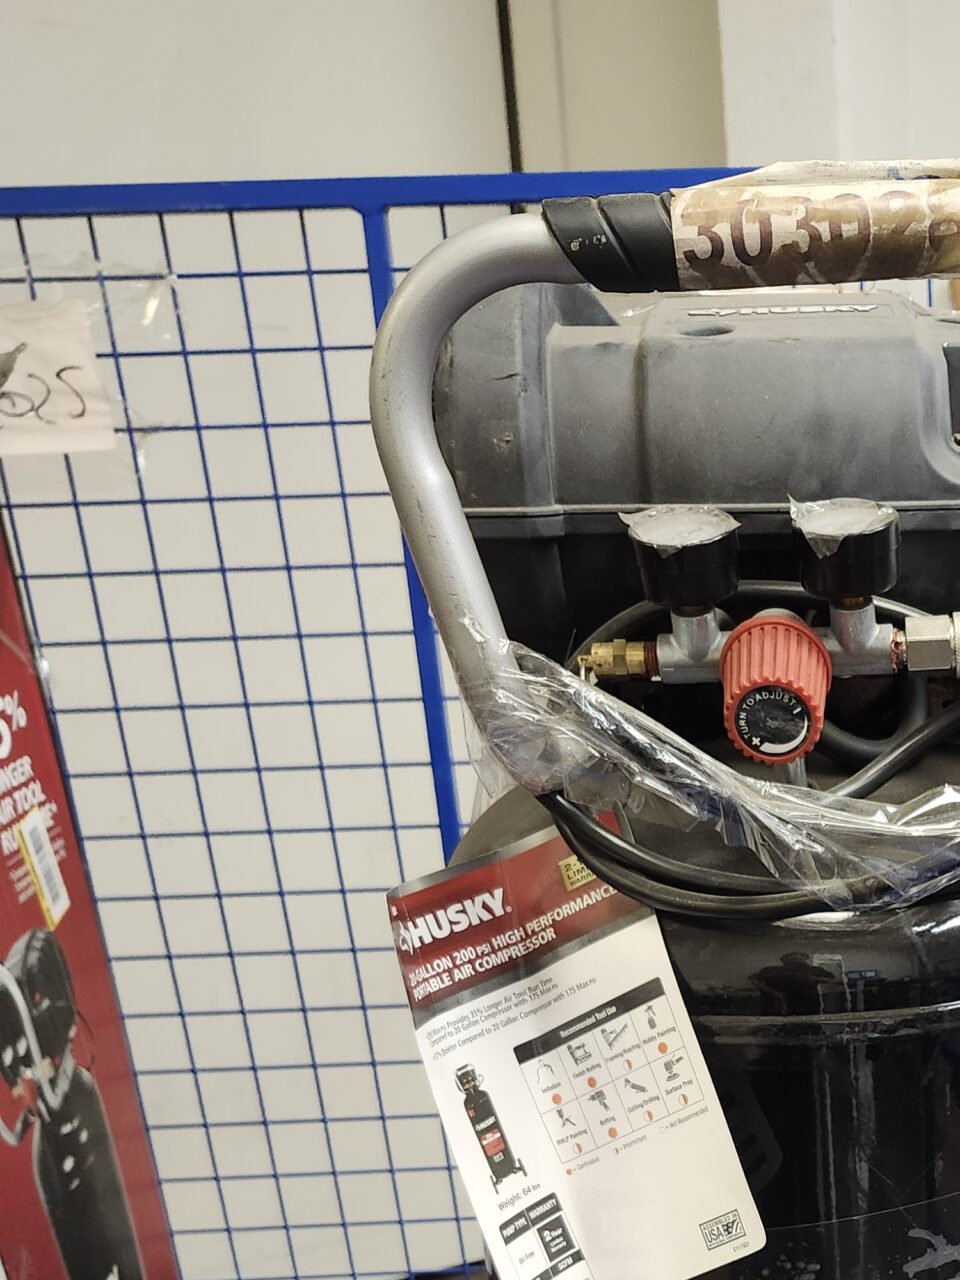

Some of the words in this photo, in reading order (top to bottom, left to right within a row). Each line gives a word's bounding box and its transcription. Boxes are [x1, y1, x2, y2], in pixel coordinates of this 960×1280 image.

[742, 697, 755, 711] TO
[755, 690, 797, 707] ADJUST
[739, 712, 750, 740] TURN
[453, 946, 476, 964] 200
[476, 944, 491, 955] PSI
[492, 927, 525, 949] HIGH
[526, 885, 618, 934] PERFORMANCE
[452, 963, 475, 981] AIR
[475, 928, 556, 972] COMPRESSOR
[447, 1013, 470, 1028] Provides
[470, 1007, 482, 1018] 35%
[484, 999, 503, 1013] Longer
[503, 995, 512, 1004] Air
[513, 989, 526, 1000] Tool
[528, 983, 540, 994] Run
[540, 977, 553, 987] Time
[454, 1025, 462, 1034] 20
[462, 1018, 479, 1030] Gallon
[480, 1003, 512, 1023] Compressor
[513, 997, 528, 1008] with
[529, 991, 539, 1001] 175
[458, 1030, 485, 1048] Compared
[492, 1023, 499, 1031] 20
[500, 1014, 518, 1027] Gallon
[520, 999, 552, 1020] Compressor
[552, 993, 565, 1004] with
[566, 987, 576, 997] 175
[576, 981, 588, 991] Max
[560, 1016, 596, 1038] Recommended
[596, 1011, 606, 1019] Tool
[606, 1006, 616, 1015] Use
[658, 1025, 676, 1038] Painting
[665, 1085, 679, 1095] Surface
[680, 1079, 693, 1089] Prep
[678, 1106, 709, 1124] Recommended
[569, 1127, 587, 1140] Painting
[498, 1192, 522, 1211] Weight:
[522, 1186, 532, 1195] 64
[529, 1199, 557, 1218] WARRANTY
[703, 1216, 730, 1230] ASSEMBLED
[543, 1230, 552, 1241] 2
[552, 1228, 562, 1237] Year
[705, 1226, 723, 1242] USA
